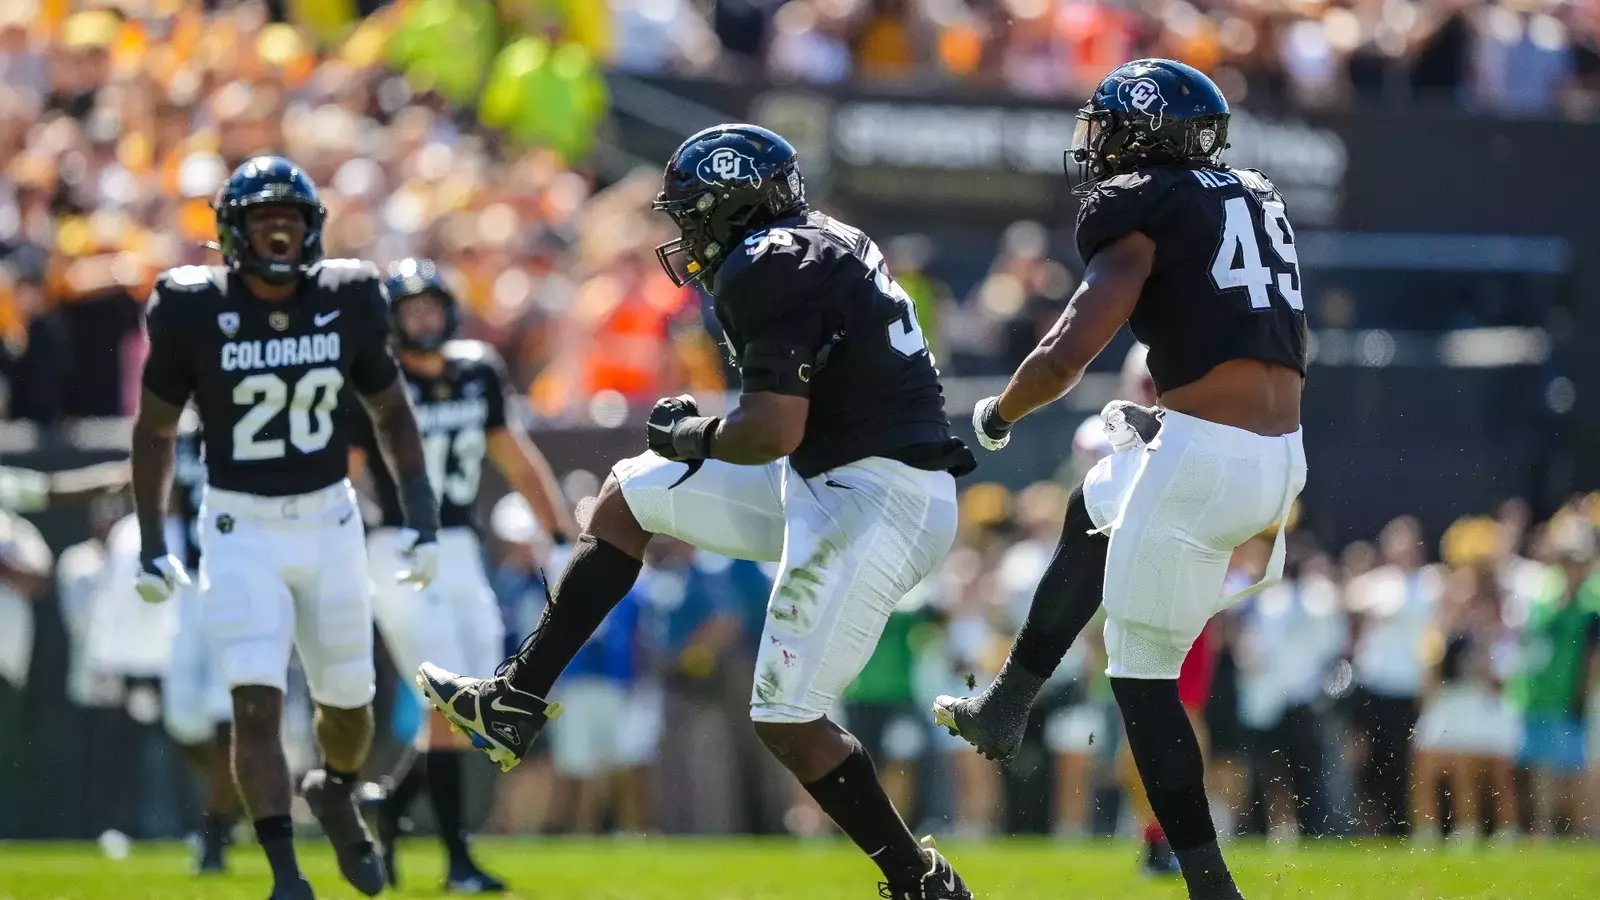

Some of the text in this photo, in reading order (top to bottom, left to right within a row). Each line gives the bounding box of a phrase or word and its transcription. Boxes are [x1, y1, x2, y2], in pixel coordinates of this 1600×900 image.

[1130, 81, 1158, 110] CU
[713, 151, 741, 180] CU
[1211, 196, 1304, 311] 49
[221, 332, 341, 371] COLORADO
[232, 368, 344, 461] 20
